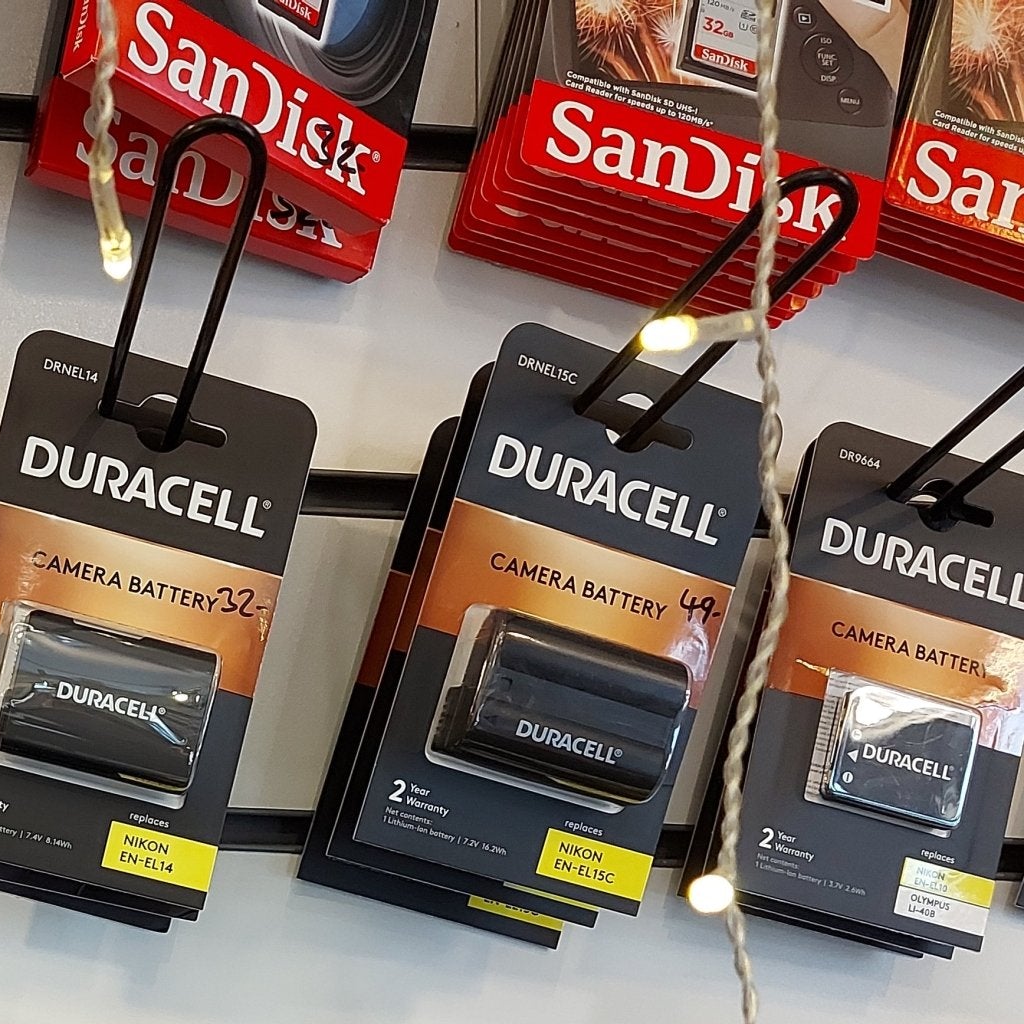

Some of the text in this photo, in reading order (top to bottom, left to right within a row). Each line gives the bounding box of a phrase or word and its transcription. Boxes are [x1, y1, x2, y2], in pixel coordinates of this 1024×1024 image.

[702, 48, 748, 72] SanDisk
[127, 1, 370, 196] SanDisk
[565, 79, 676, 118] Card Reader for speeds up to
[566, 70, 698, 114] Compatible with SanDisk SD UHS-I
[44, 358, 99, 383] DRNEL14
[518, 354, 578, 385] DRNEL15C
[839, 448, 881, 470] DR9664
[20, 435, 266, 538] DURACELL
[488, 434, 719, 546] DURACELL
[31, 551, 219, 613] CAMERA BATTERY
[490, 552, 668, 620] CAMERA BATTERY
[831, 621, 910, 657] CAMERA
[56, 681, 158, 721] DURACELL
[515, 719, 617, 765] DURACELL
[863, 743, 952, 781] DURACELL
[409, 783, 431, 798] Year
[405, 795, 450, 818] Warranty
[129, 811, 170, 829] replaces
[564, 819, 603, 838] replaces
[124, 833, 169, 855] NIKON
[776, 830, 796, 843] Year
[120, 850, 174, 874] EN-EL14
[559, 842, 604, 864] NIKON
[774, 842, 815, 862] Warranty
[921, 848, 955, 865] replaces
[554, 859, 616, 884] EN-EL15C
[916, 866, 946, 881] NIKON
[910, 894, 950, 911] OLYMPUS
